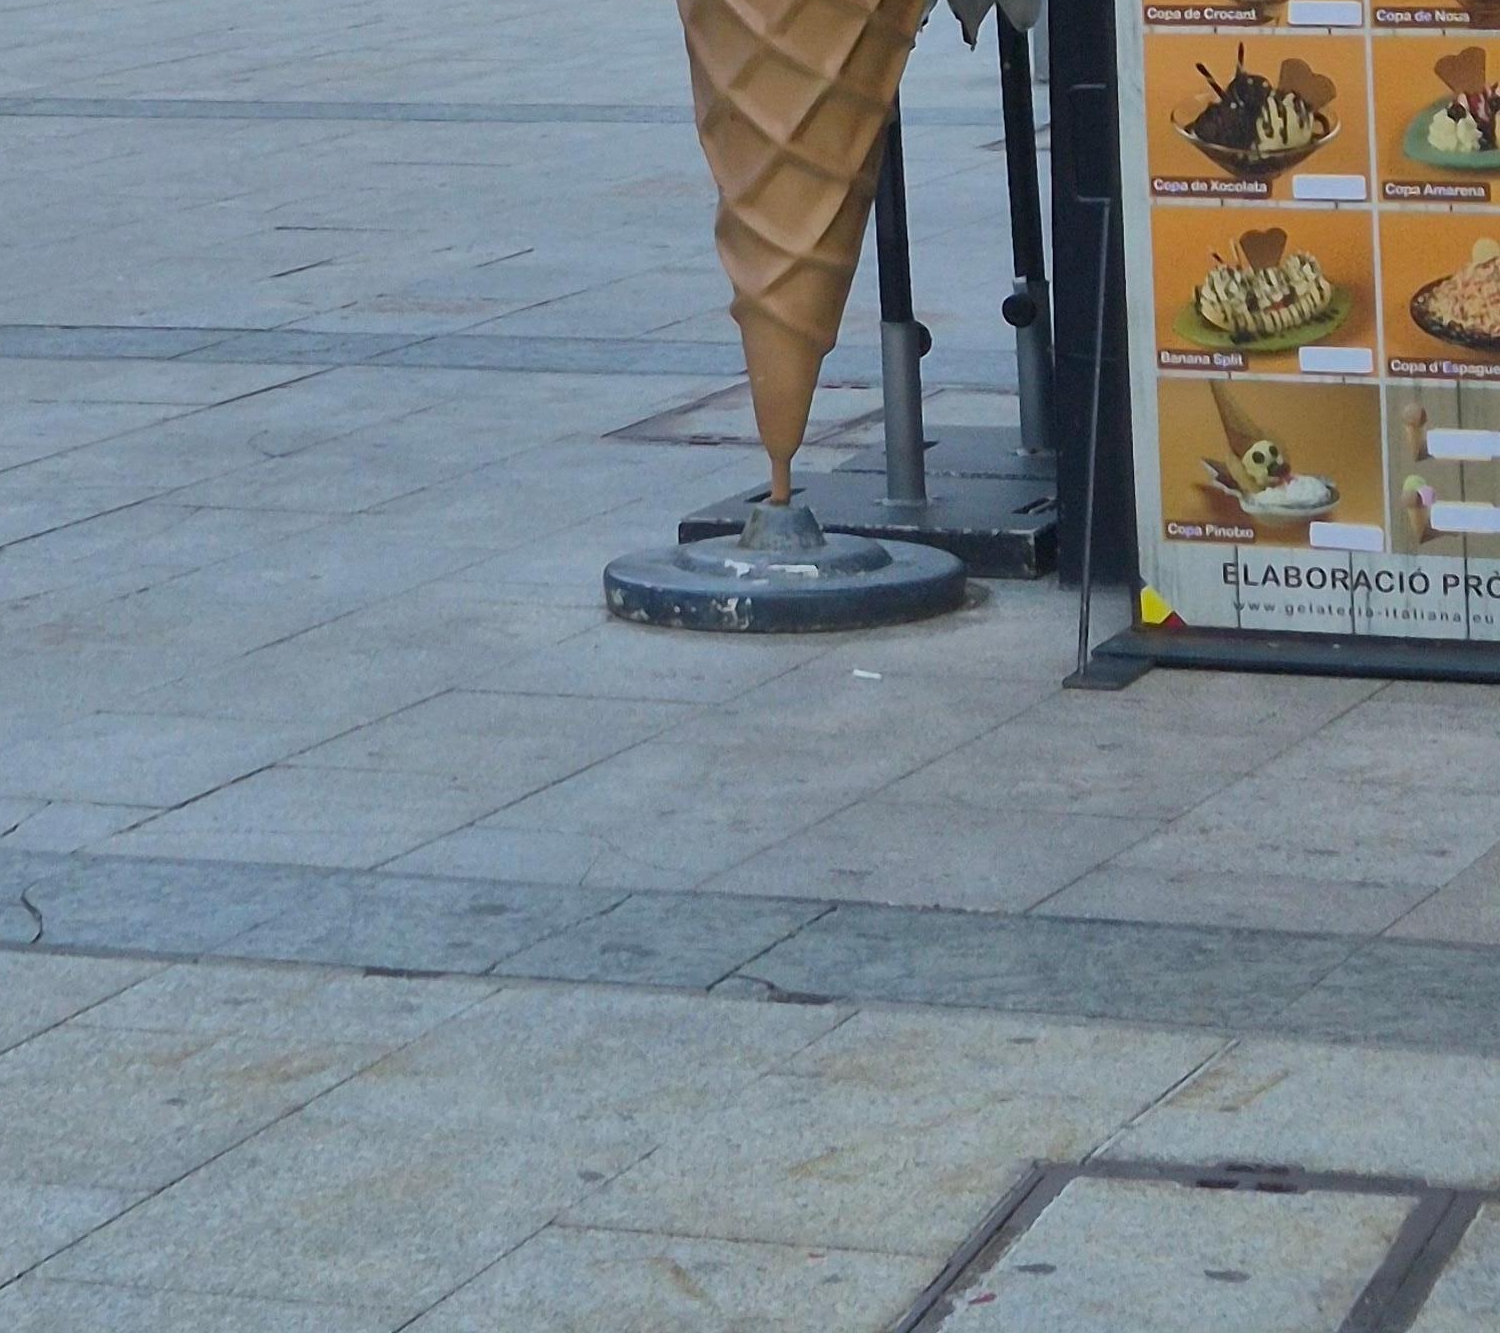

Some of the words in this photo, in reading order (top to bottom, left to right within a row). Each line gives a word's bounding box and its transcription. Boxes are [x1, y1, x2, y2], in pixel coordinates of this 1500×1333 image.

[1147, 7, 1182, 21] Copa
[1184, 8, 1201, 20] de
[1203, 7, 1257, 21] Crocant
[1376, 9, 1412, 23] Copa
[1414, 11, 1433, 22] de
[1153, 178, 1189, 192] Copa
[1385, 182, 1421, 197] Copa
[1423, 183, 1485, 197] Amarena
[1160, 351, 1211, 365] Banana
[1213, 353, 1244, 367] Split
[1390, 359, 1427, 374] Copa
[1168, 522, 1203, 537] Copa
[1222, 562, 1430, 595] ELABORACIÓ
